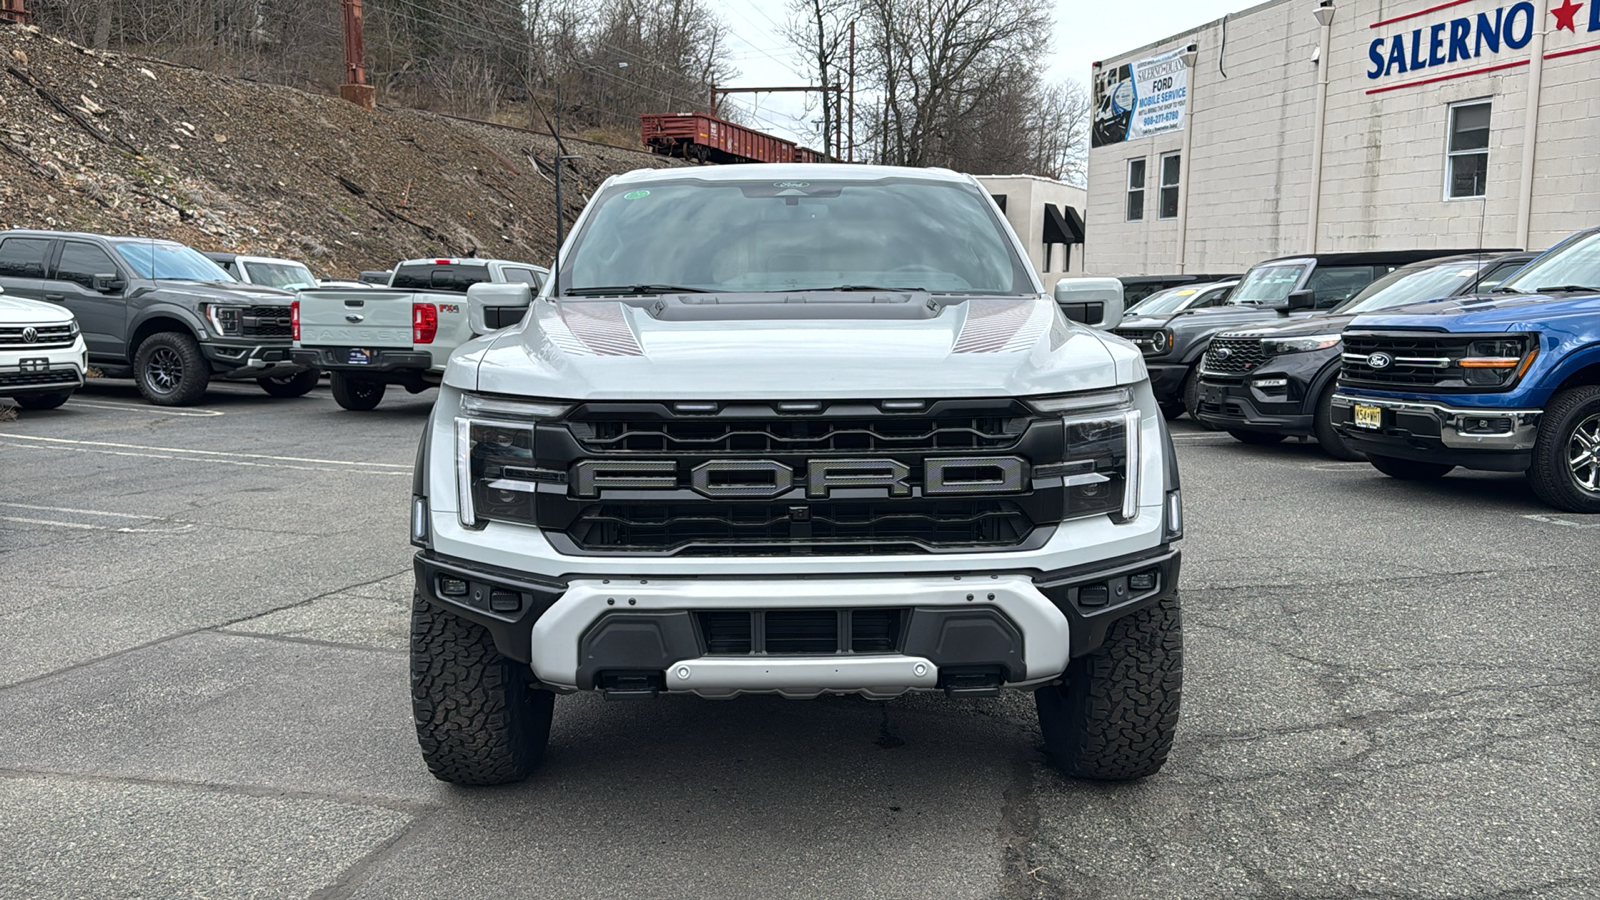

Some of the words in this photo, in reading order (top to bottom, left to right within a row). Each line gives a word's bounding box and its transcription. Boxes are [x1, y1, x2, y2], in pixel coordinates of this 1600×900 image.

[1367, 1, 1535, 79] SALERNO
[1152, 76, 1173, 93] FORD
[1139, 92, 1160, 108] MOBILE
[1161, 87, 1186, 102] SERVICE
[439, 304, 459, 314] FX4
[303, 328, 410, 341] RANGER
[1369, 354, 1386, 366] Ford
[573, 458, 1027, 497] FORD
